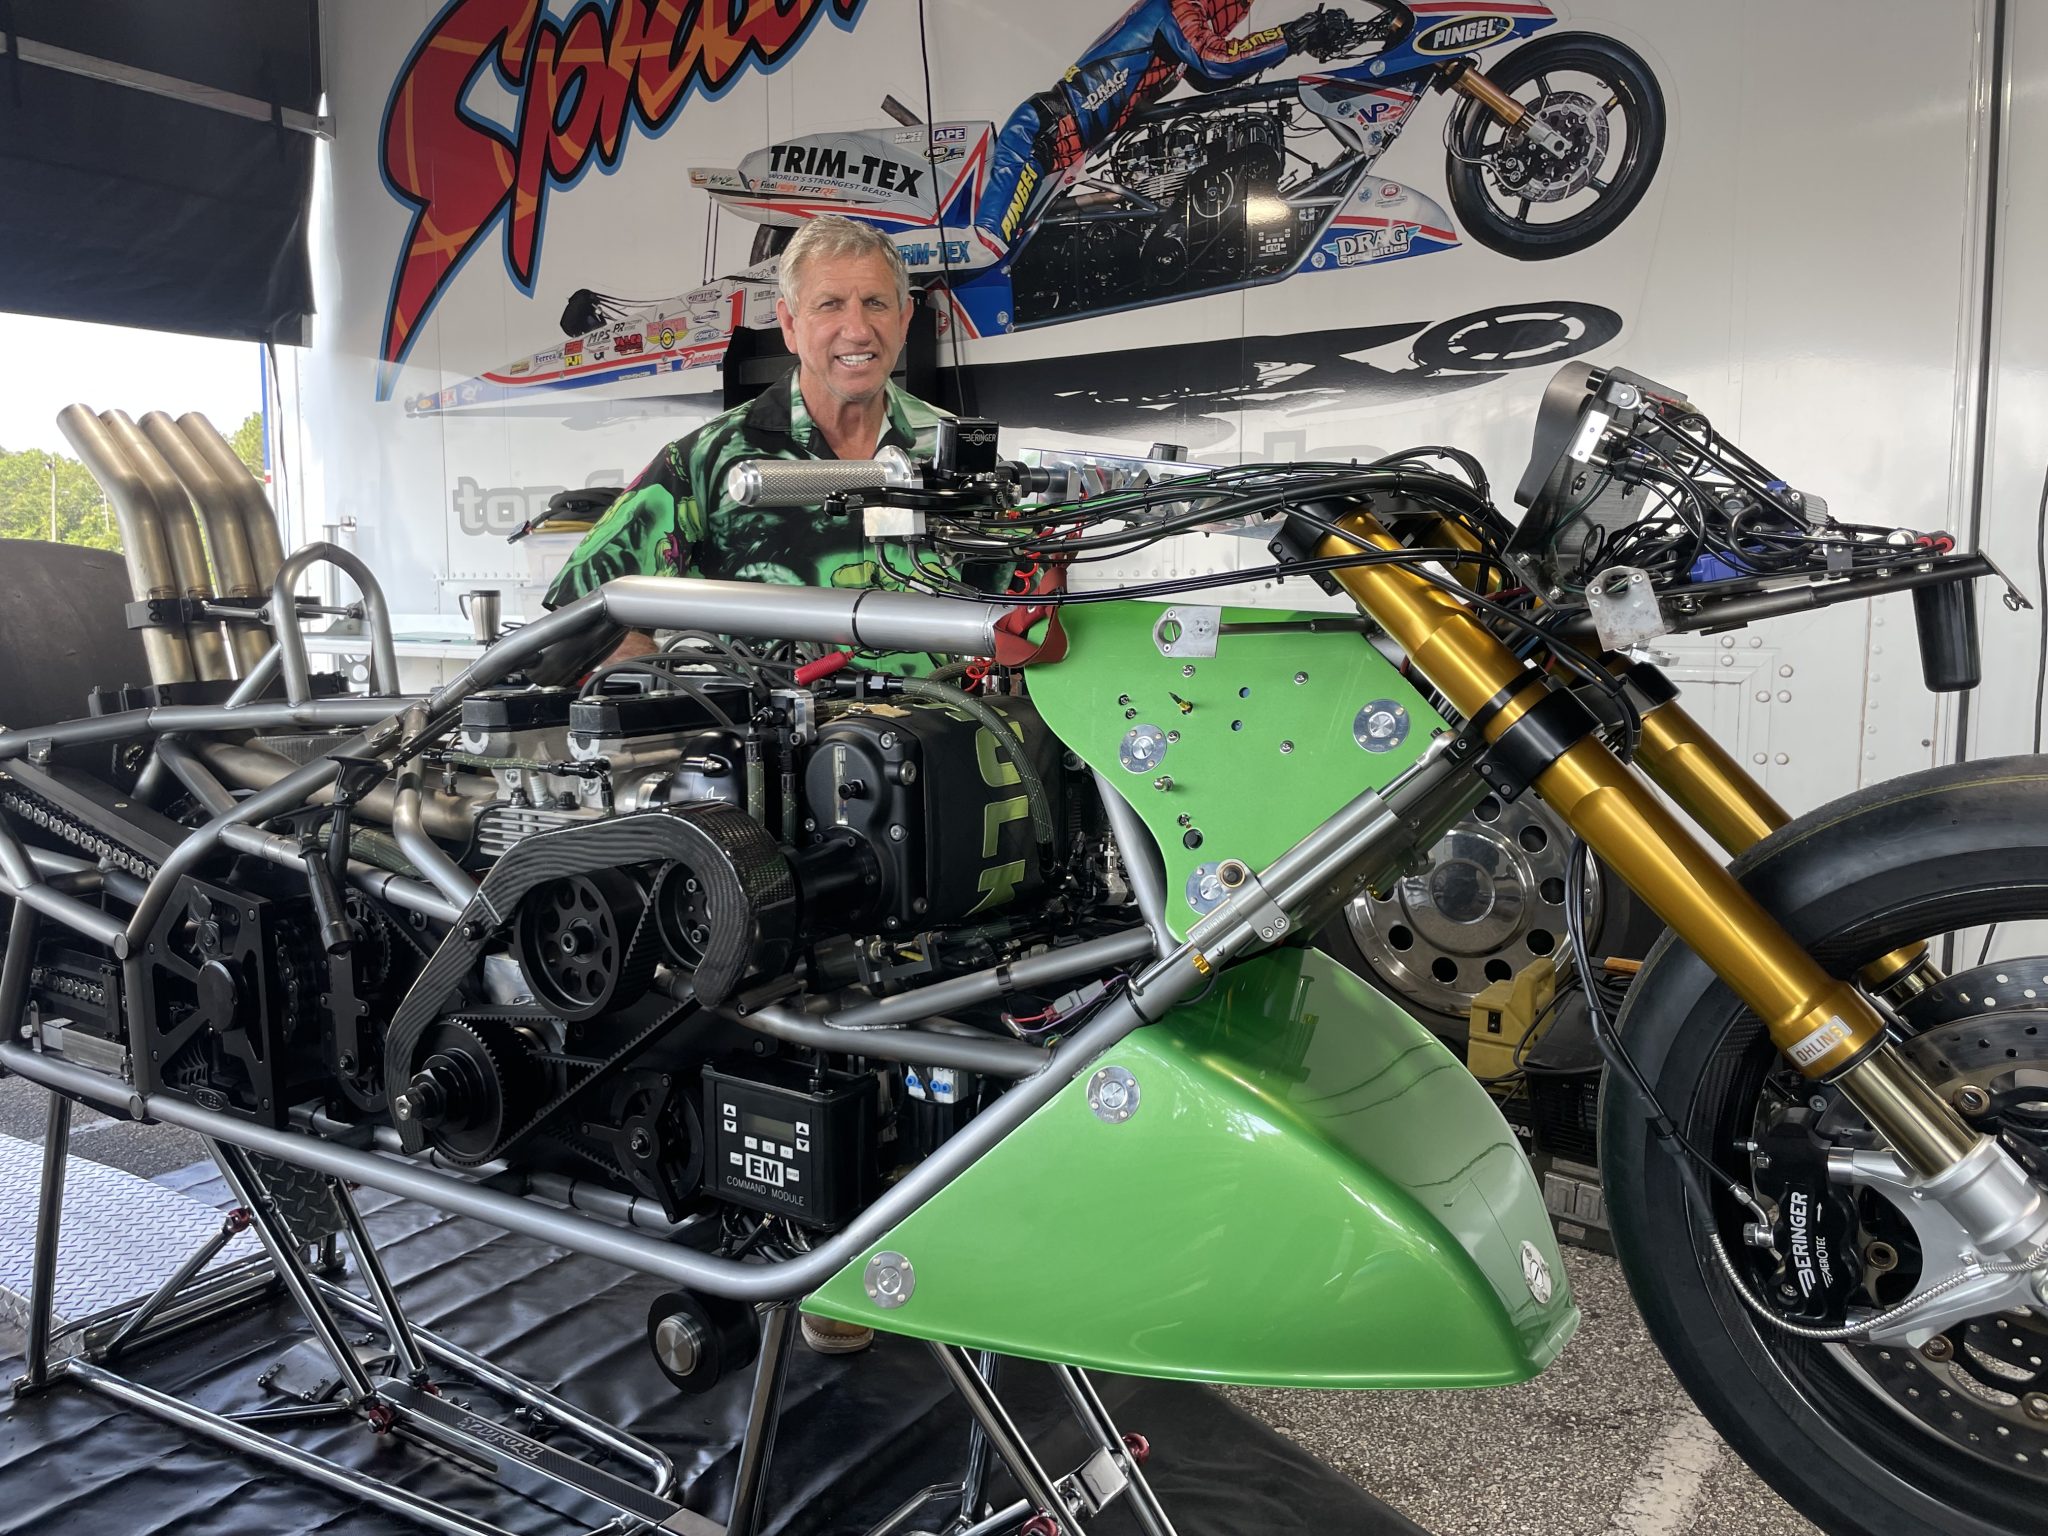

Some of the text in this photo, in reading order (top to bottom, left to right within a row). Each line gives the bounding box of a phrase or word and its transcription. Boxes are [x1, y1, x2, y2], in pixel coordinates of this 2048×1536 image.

[1433, 18, 1497, 49] PINGEL
[1086, 70, 1125, 106] DRAG
[1359, 103, 1390, 123] VP
[935, 129, 964, 141] APE
[770, 145, 925, 199] TRIM-TEX
[808, 177, 861, 190] STRONGEST
[862, 185, 894, 198] BEADS
[1337, 225, 1409, 257] DRAG
[587, 329, 611, 344] MPS
[565, 355, 582, 367] PJ1
[750, 1157, 779, 1183] EM
[726, 1175, 805, 1206] COMMAND MODULE
[1790, 1191, 1816, 1299] BERINGER
[1816, 1235, 1833, 1289] AEROTEC
